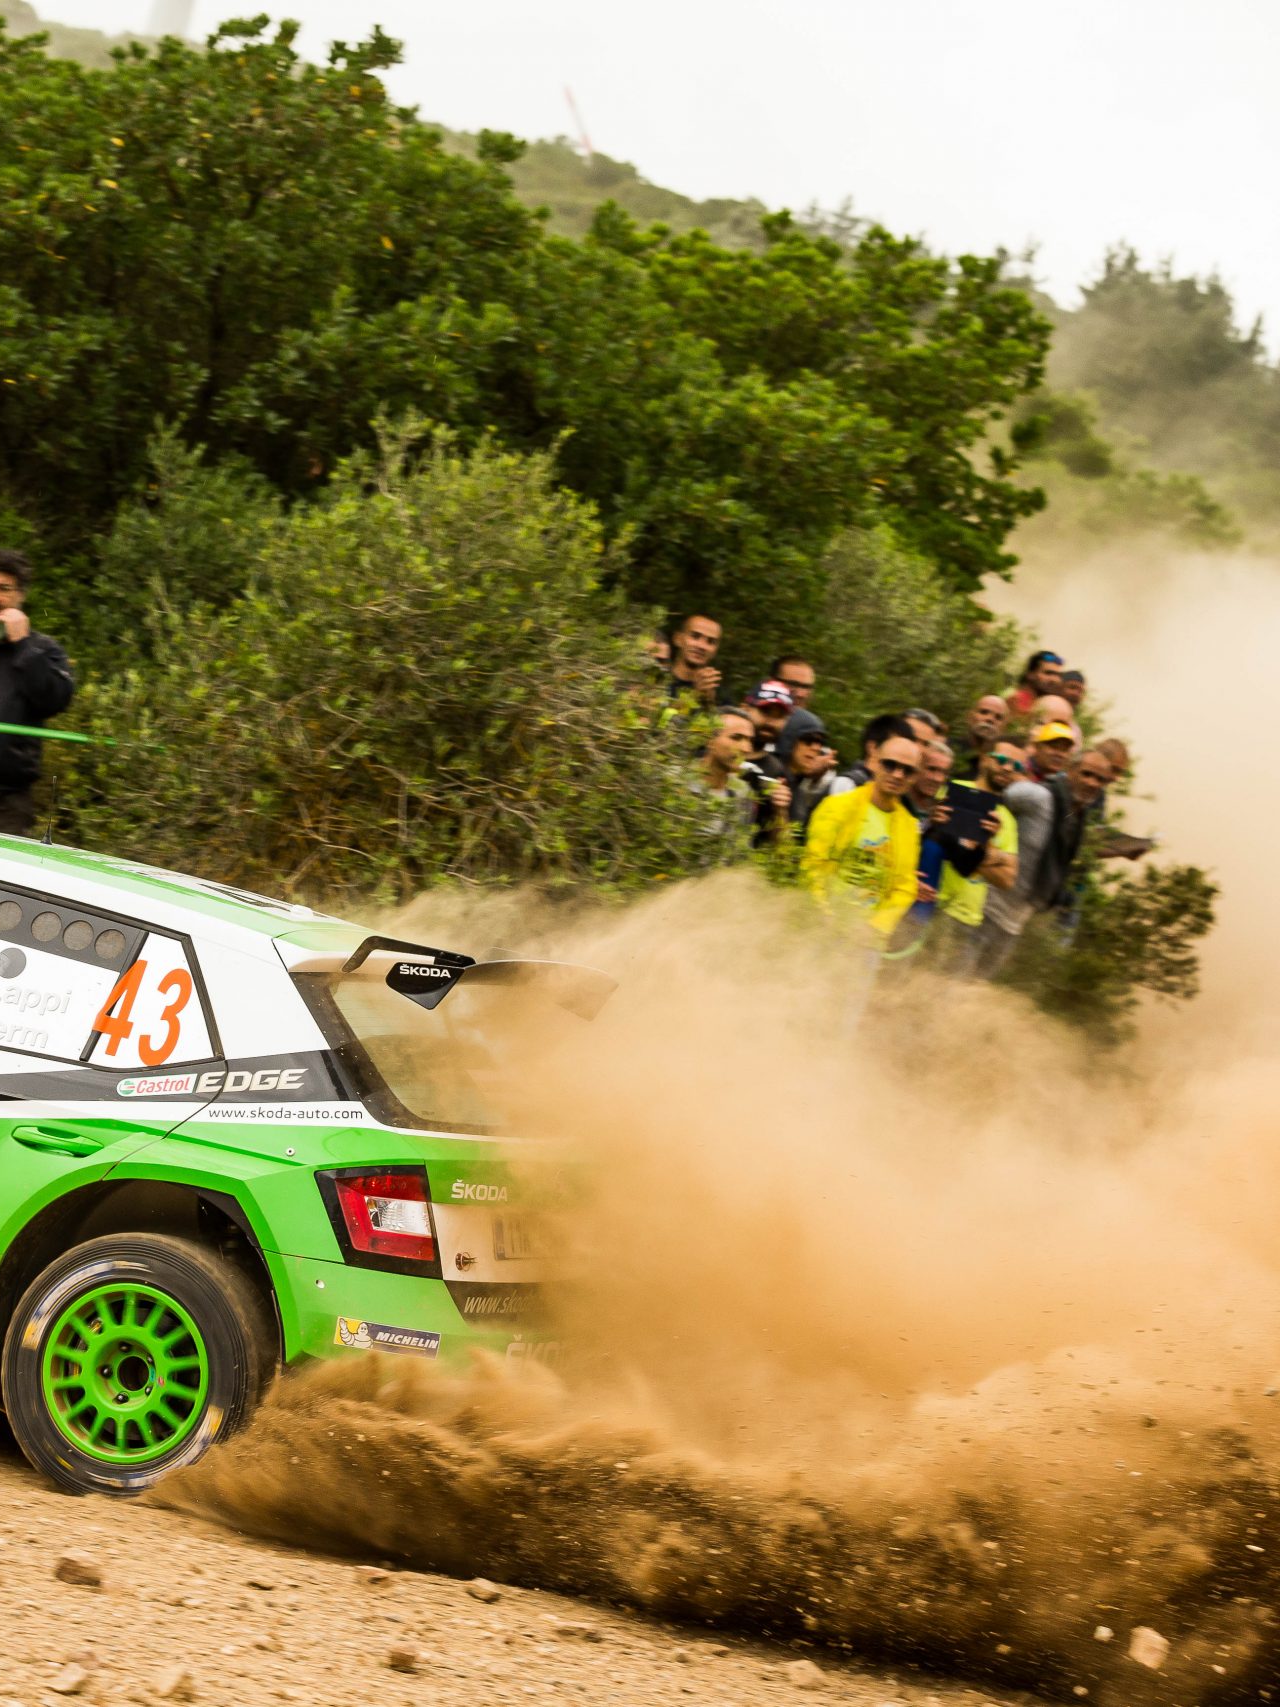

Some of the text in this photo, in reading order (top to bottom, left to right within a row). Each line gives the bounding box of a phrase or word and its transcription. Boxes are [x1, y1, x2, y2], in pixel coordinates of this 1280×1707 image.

[399, 963, 451, 979] ŠKODA
[92, 959, 193, 1067] 43
[136, 1068, 309, 1095] Castrol EDGE
[208, 1106, 363, 1121] www.skoda-auto.com
[450, 1178, 508, 1202] ŠKODA
[375, 1331, 439, 1350] MICHELIN
